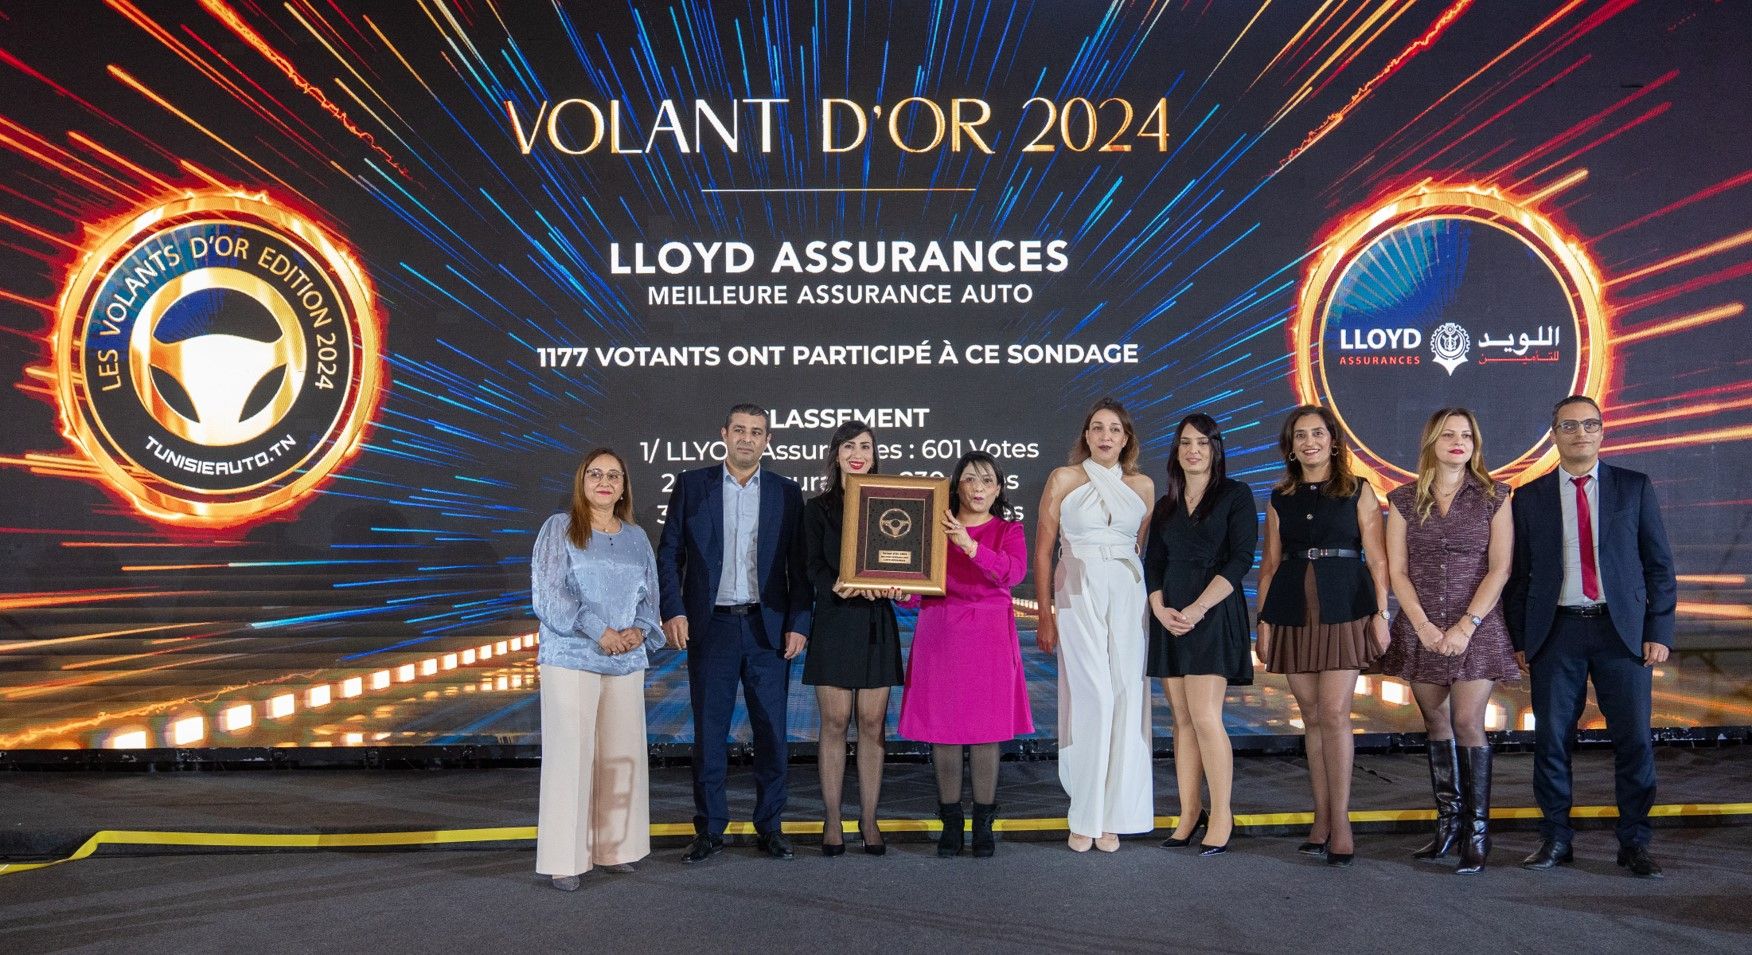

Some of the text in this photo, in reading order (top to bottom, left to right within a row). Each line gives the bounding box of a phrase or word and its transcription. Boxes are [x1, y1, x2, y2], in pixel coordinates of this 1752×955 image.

[504, 99, 790, 154] VOLANT
[1022, 97, 1169, 152] 2024
[611, 240, 1069, 274] LLOYD ASSURANCES
[101, 244, 182, 336] VOLANTS
[257, 246, 332, 328] EDITION
[648, 283, 1033, 305] MEILLEURE ASSURANCE AUTO
[537, 339, 1139, 368] 1177 VOTANTS ONT PARTICIPÉ À CE SONDAGE
[1340, 328, 1422, 349] LLOYD
[1478, 325, 1560, 356] اللويد
[98, 348, 119, 391] LES
[315, 333, 337, 391] 2024
[1340, 355, 1421, 365] ASSURANCES
[765, 409, 930, 429] LASSEMENT
[144, 434, 297, 475] TUNISIEAUTO.TN
[640, 438, 660, 464] 1/
[667, 441, 728, 461] LLYO
[922, 440, 961, 460] 601
[969, 439, 1040, 459] Votes
